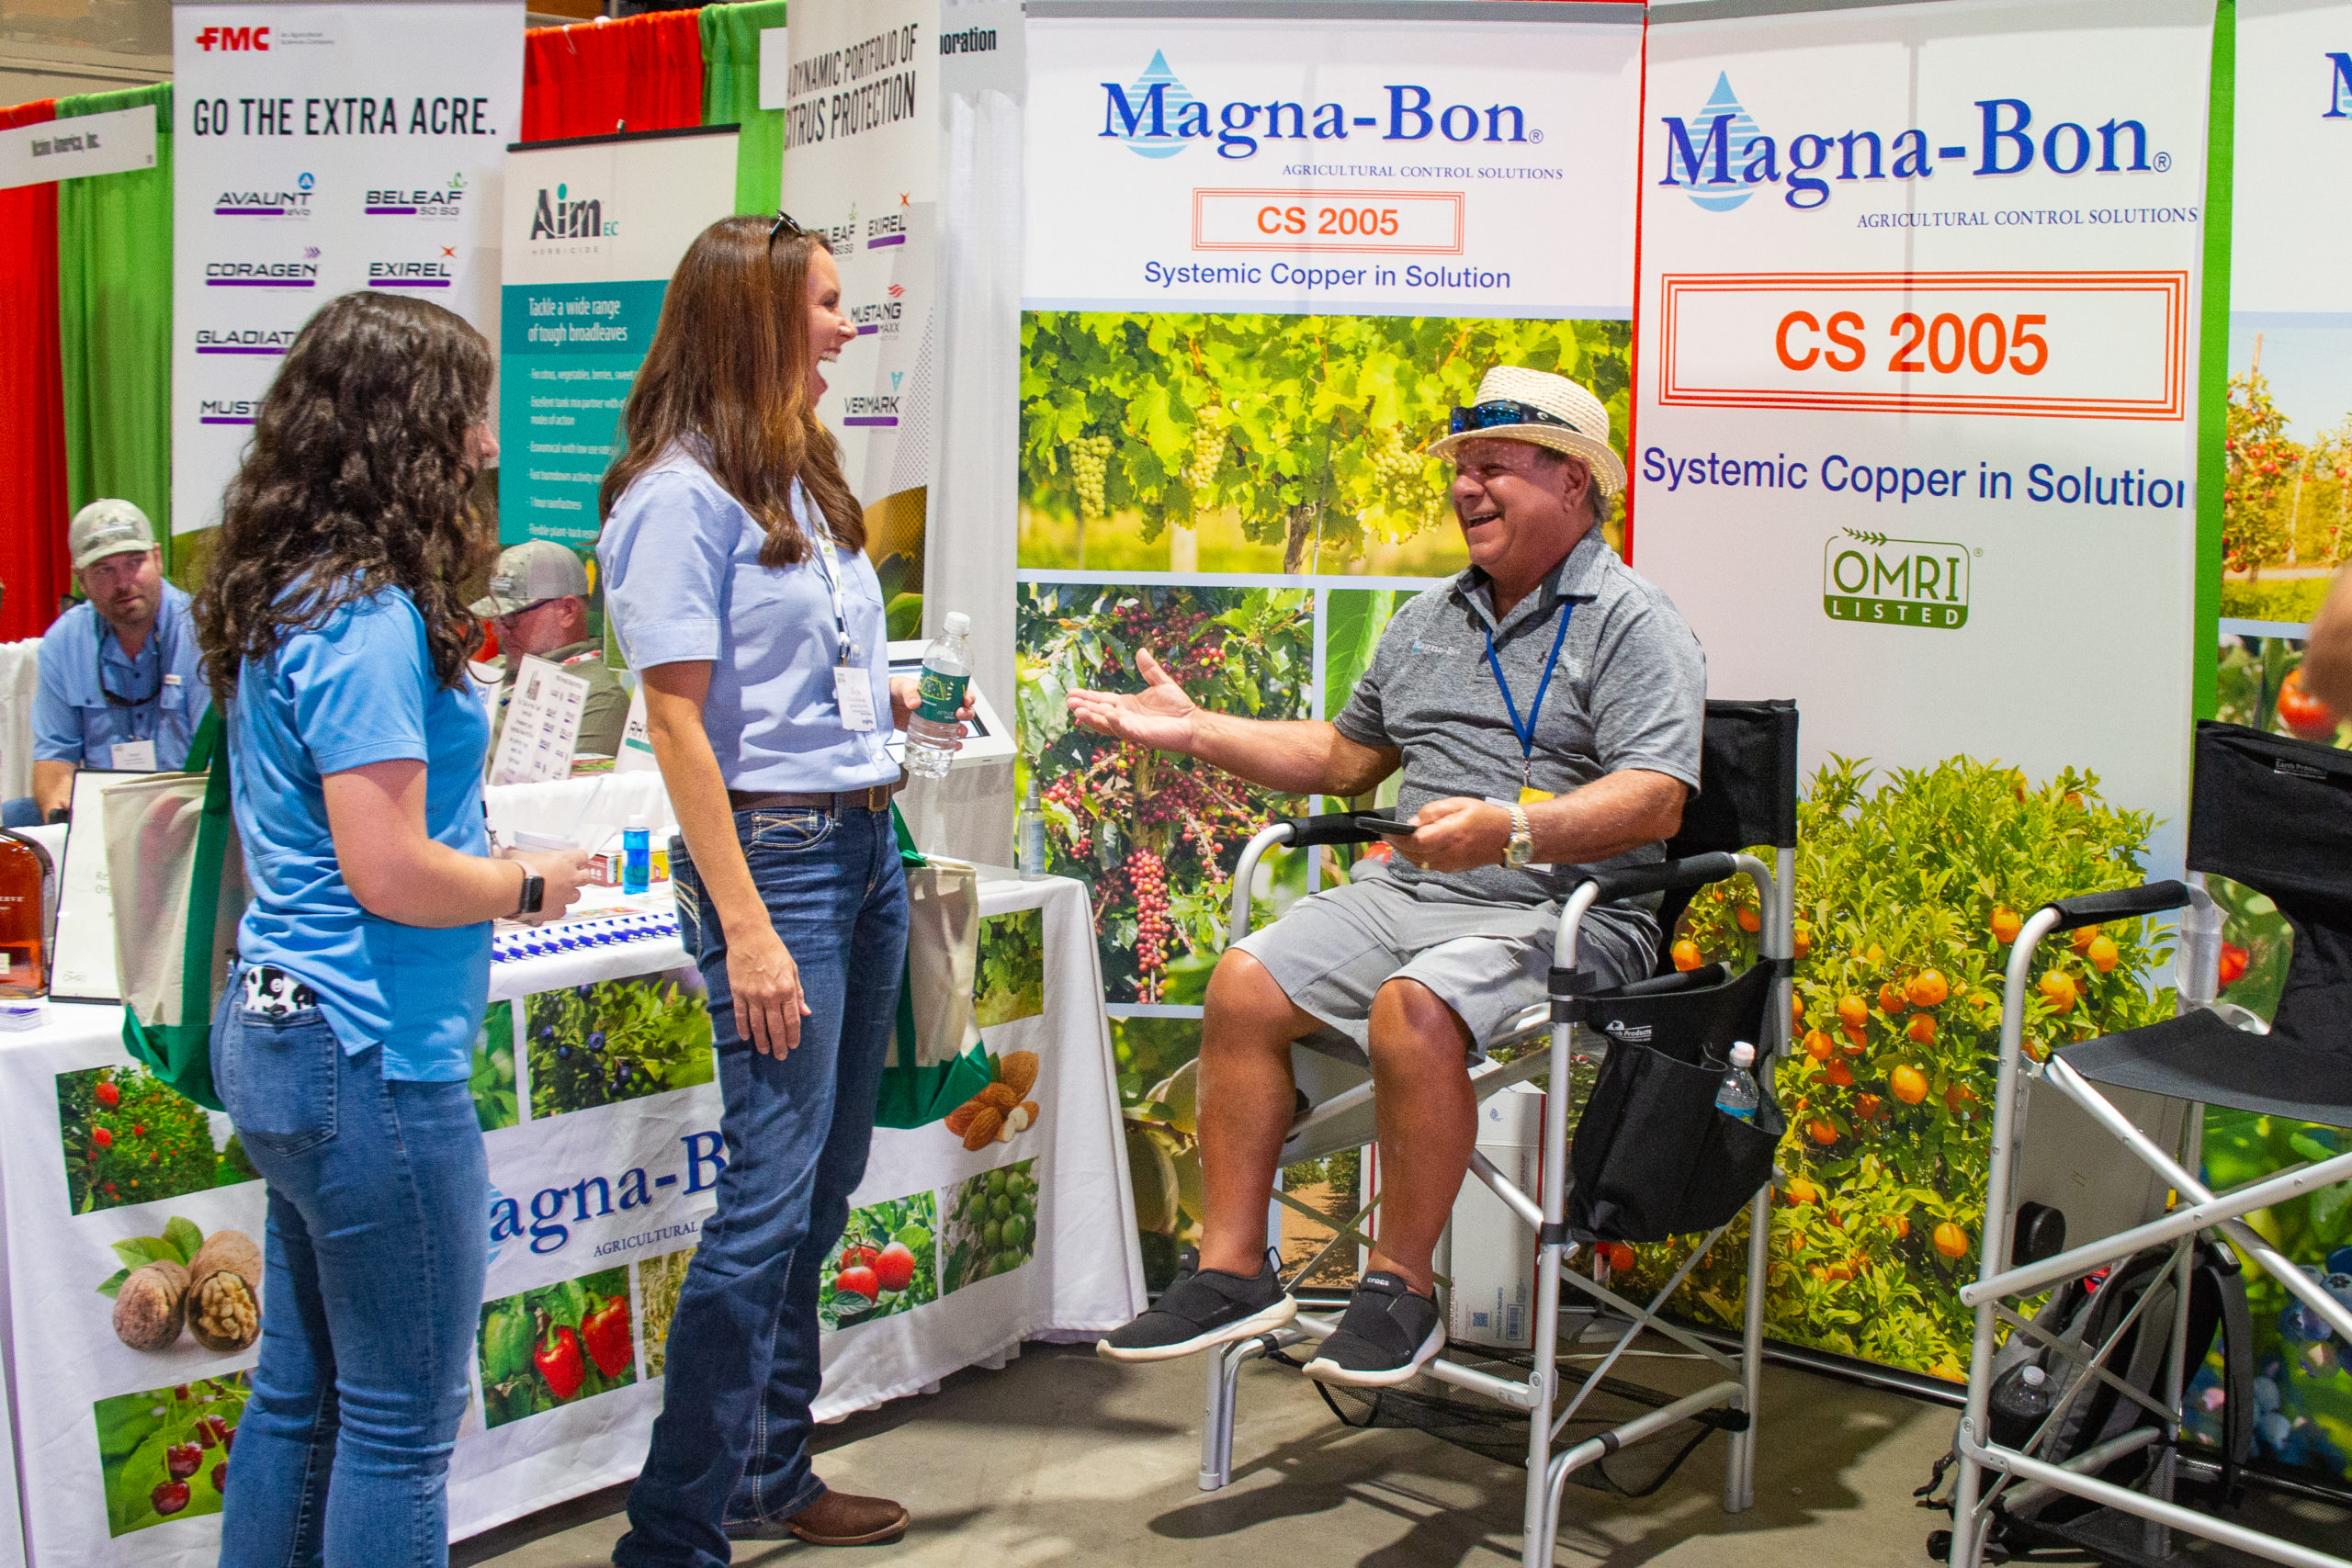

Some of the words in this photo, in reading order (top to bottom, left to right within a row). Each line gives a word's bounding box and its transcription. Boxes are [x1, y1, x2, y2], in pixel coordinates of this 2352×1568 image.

[194, 27, 270, 51] FMC
[940, 27, 996, 54] oration
[790, 50, 841, 97] DYNAMIC
[843, 29, 898, 84] PORTFOLIO
[900, 22, 918, 63] OF
[193, 98, 228, 135] GO
[239, 98, 294, 135] THE
[304, 97, 397, 135] EXTRA
[409, 97, 496, 135] ACRE.
[831, 70, 916, 139] PROTECTION
[1283, 164, 1396, 177] AGRICULTURAL
[1400, 166, 1474, 179] CONTROL
[1476, 167, 1563, 180] SOLUTIONS
[216, 191, 313, 205] AVAUNT
[365, 190, 464, 204] BELEAF
[529, 183, 601, 240] Aim
[1257, 207, 1306, 235] CS
[1318, 208, 1398, 237] 2005
[1857, 210, 1989, 229] AGRICULTURAL
[1994, 209, 2084, 227] CONTROL
[2088, 207, 2198, 225] SOLUTIONS
[603, 221, 618, 236] EC
[818, 223, 855, 243] LEAF
[868, 214, 907, 237] EXIREL
[206, 263, 318, 276] CORAGEN
[369, 263, 451, 276] EXIREL
[1145, 261, 1261, 289] Systemic
[1270, 262, 1366, 290] Copper
[1375, 264, 1396, 287] in
[1405, 264, 1510, 288] Solution
[528, 298, 556, 316] Tackle
[557, 301, 563, 315] a
[566, 296, 591, 315] wide
[592, 299, 621, 320] range
[851, 301, 902, 323] MUSTANG
[527, 323, 538, 342] of
[538, 322, 567, 346] tough
[569, 322, 628, 342] broadleaves
[1775, 310, 1866, 371] CS
[1887, 312, 2049, 376] 2005
[843, 396, 900, 413] VERIMARK
[1642, 447, 1807, 492] Systemic
[1821, 455, 1966, 503] Copper
[1978, 461, 2012, 499] in
[1832, 549, 1962, 603] OMRI
[1832, 600, 1961, 626] LISTED
[594, 1221, 698, 1258] AGRICULTURAL
[1366, 1276, 1390, 1286] crocs
